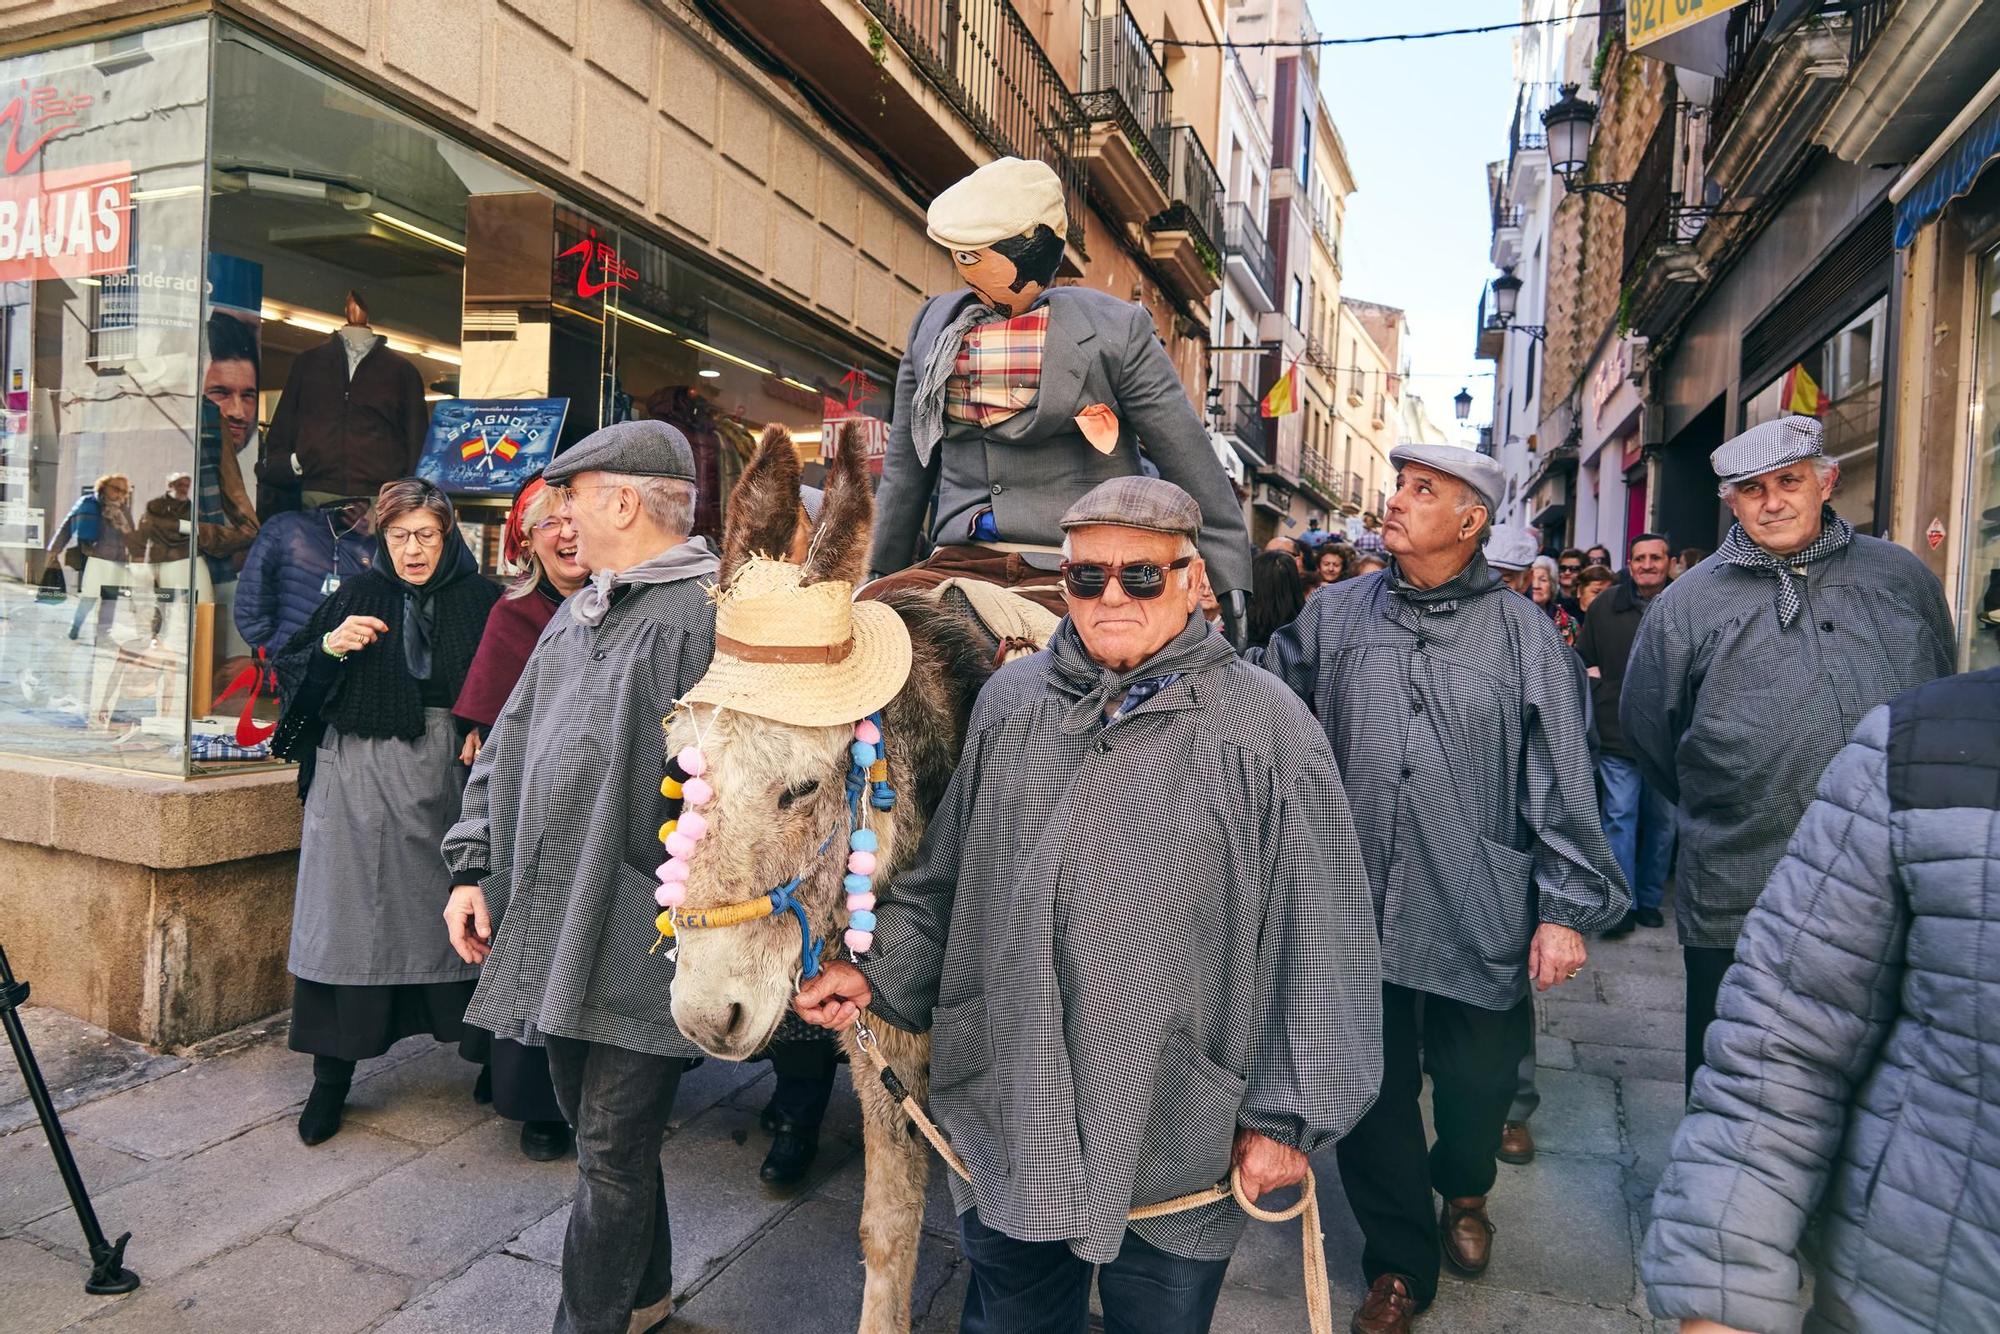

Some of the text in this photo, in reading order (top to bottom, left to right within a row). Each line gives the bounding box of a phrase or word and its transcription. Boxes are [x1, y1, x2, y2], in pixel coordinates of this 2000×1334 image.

[0, 187, 121, 261] BAJAS
[104, 271, 214, 294] abanderado
[447, 414, 540, 442] SPAGNOLO
